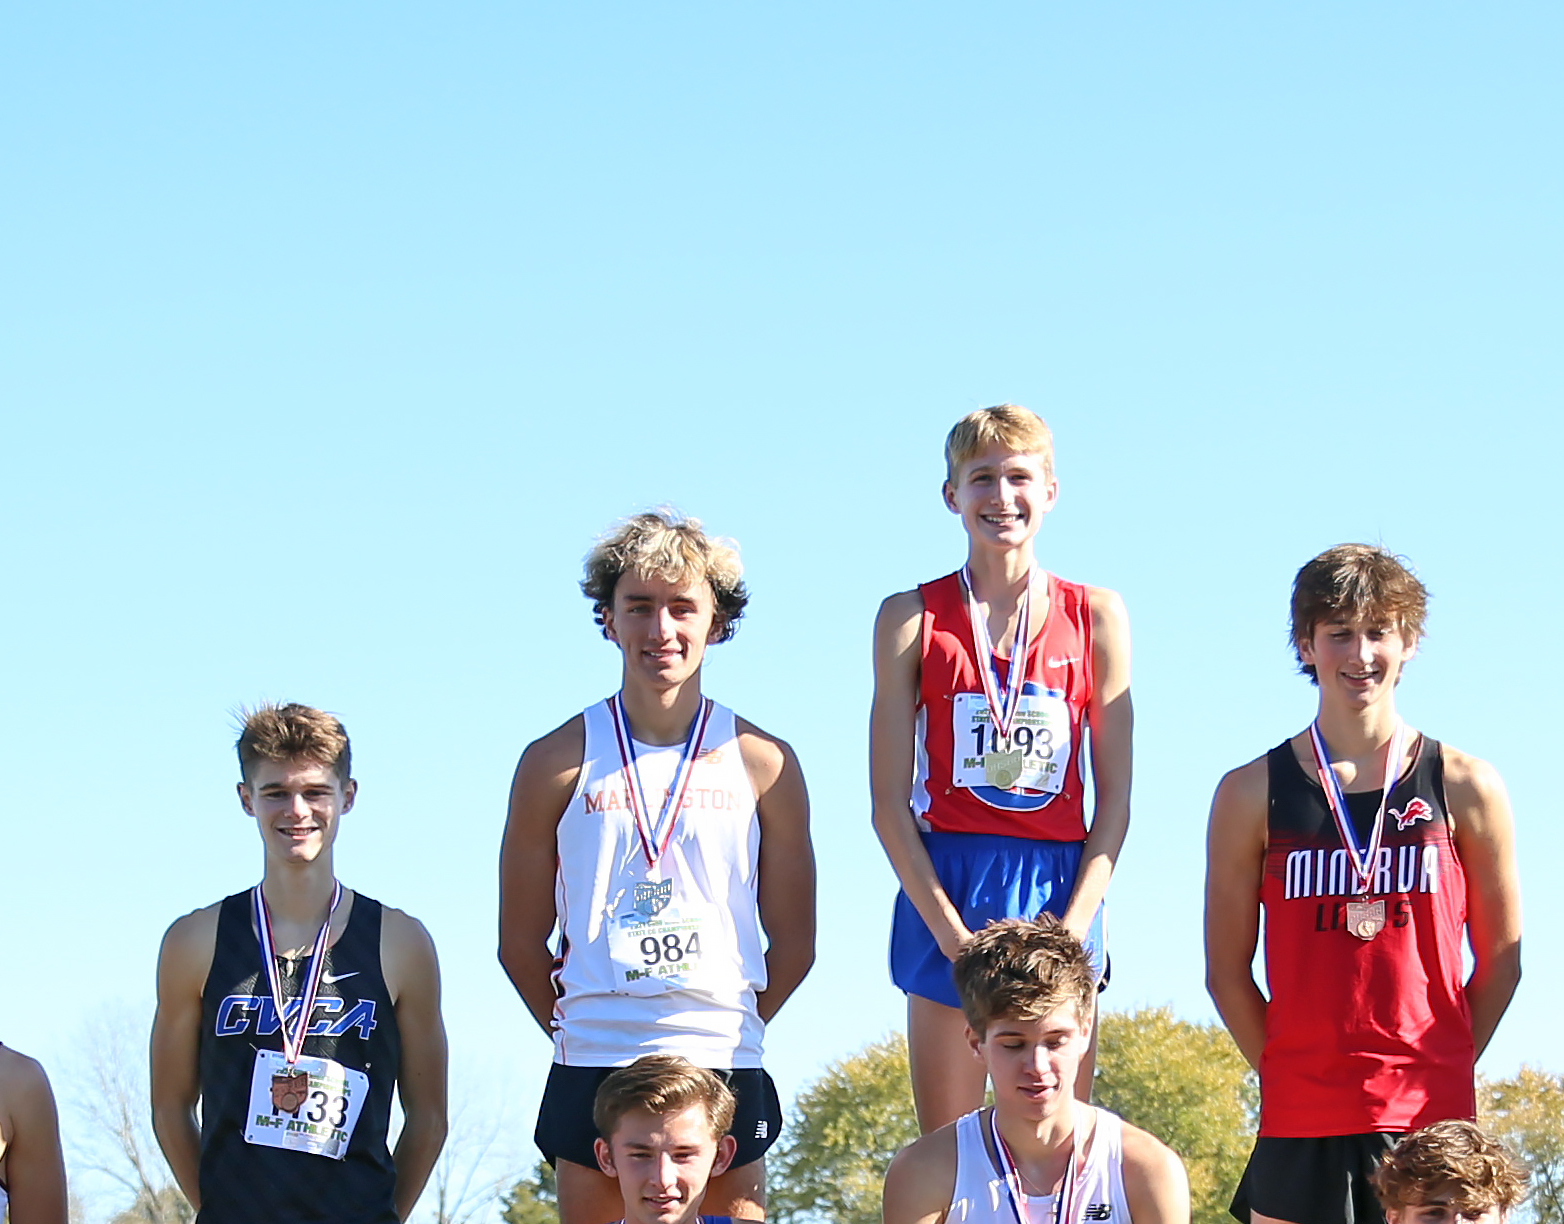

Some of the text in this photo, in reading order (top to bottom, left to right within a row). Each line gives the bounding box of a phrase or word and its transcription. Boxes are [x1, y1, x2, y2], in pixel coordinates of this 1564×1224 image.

[1315, 901, 1412, 932] LIS
[640, 932, 702, 966] 984
[625, 968, 652, 983] M-F
[216, 995, 377, 1040] CVCA
[256, 1115, 284, 1128] M-F
